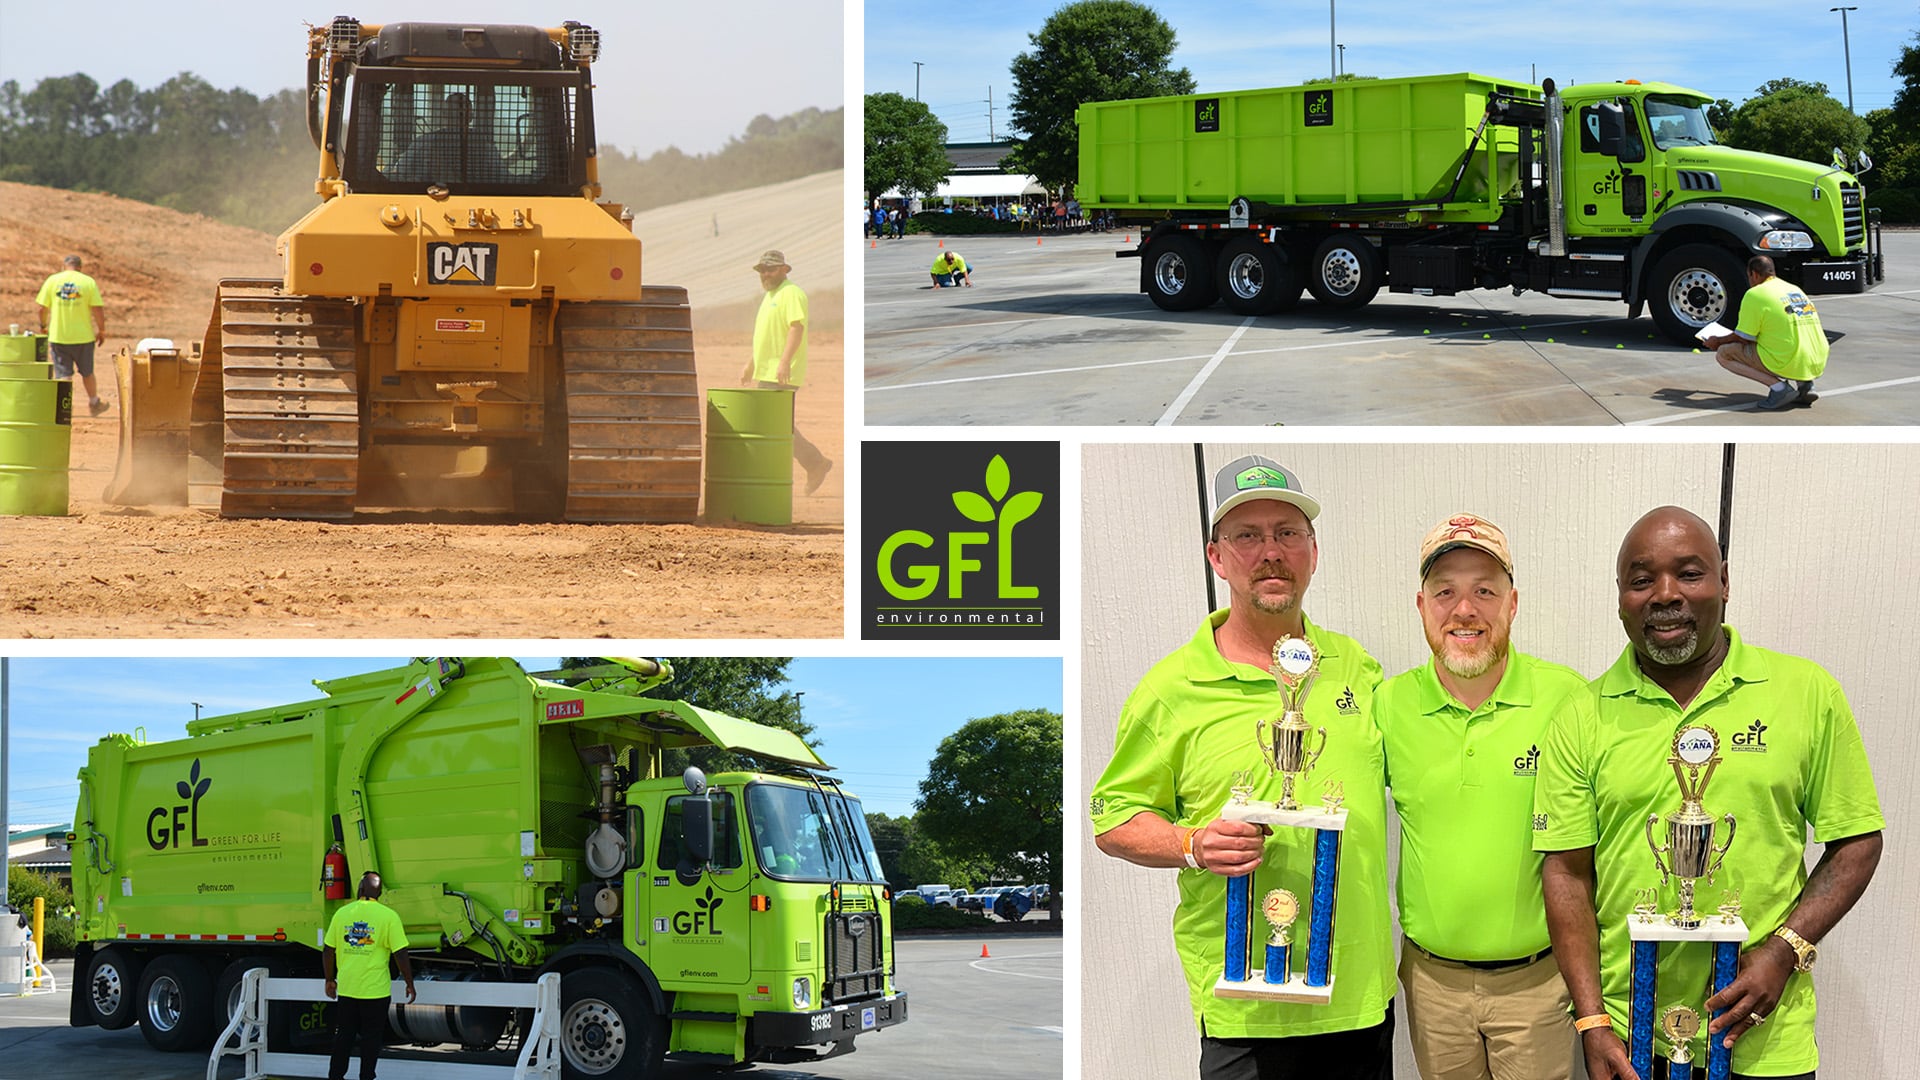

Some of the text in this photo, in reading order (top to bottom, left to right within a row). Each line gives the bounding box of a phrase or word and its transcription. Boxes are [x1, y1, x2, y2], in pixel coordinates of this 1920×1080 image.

[1199, 106, 1215, 120] GFL
[1309, 98, 1327, 113] GFL
[1593, 175, 1620, 195] GFL
[434, 246, 490, 281] CAT
[1823, 271, 1856, 281] 414051
[548, 702, 580, 716] HEIL
[1732, 726, 1767, 746] GFL
[1231, 770, 1254, 787] 20
[147, 778, 212, 850] GFL
[211, 832, 281, 847] GREEN FOR LIFE
[212, 851, 283, 863] environmental
[197, 882, 235, 894] gflenv.com
[673, 897, 723, 935] GFL
[680, 969, 718, 978] gflenv.com
[300, 1004, 327, 1030] GFL
[810, 1013, 832, 1031] 913182
